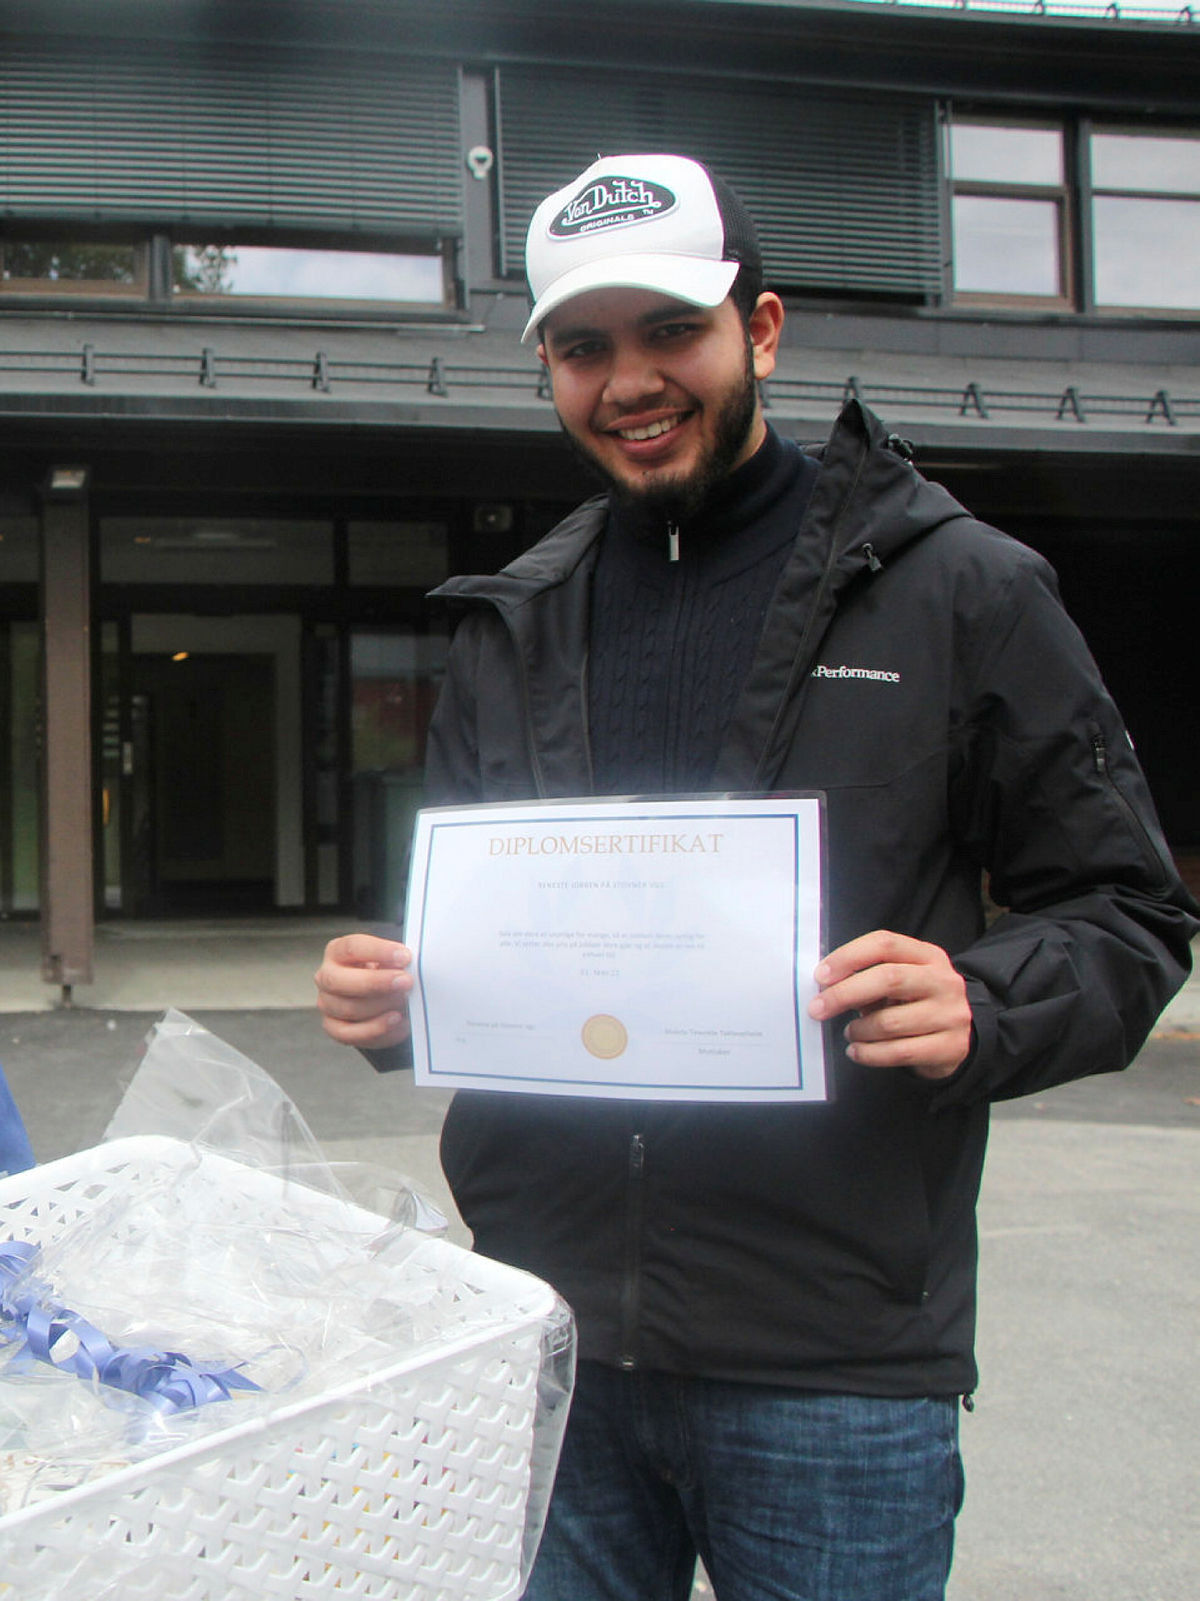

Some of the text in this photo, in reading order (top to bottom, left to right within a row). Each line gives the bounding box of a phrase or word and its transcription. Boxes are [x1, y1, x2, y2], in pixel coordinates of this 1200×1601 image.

[564, 180, 654, 222] Van Dutch
[580, 214, 634, 232] ORIGINALS
[489, 834, 724, 856] DIPLOMSERTIFIKAT
